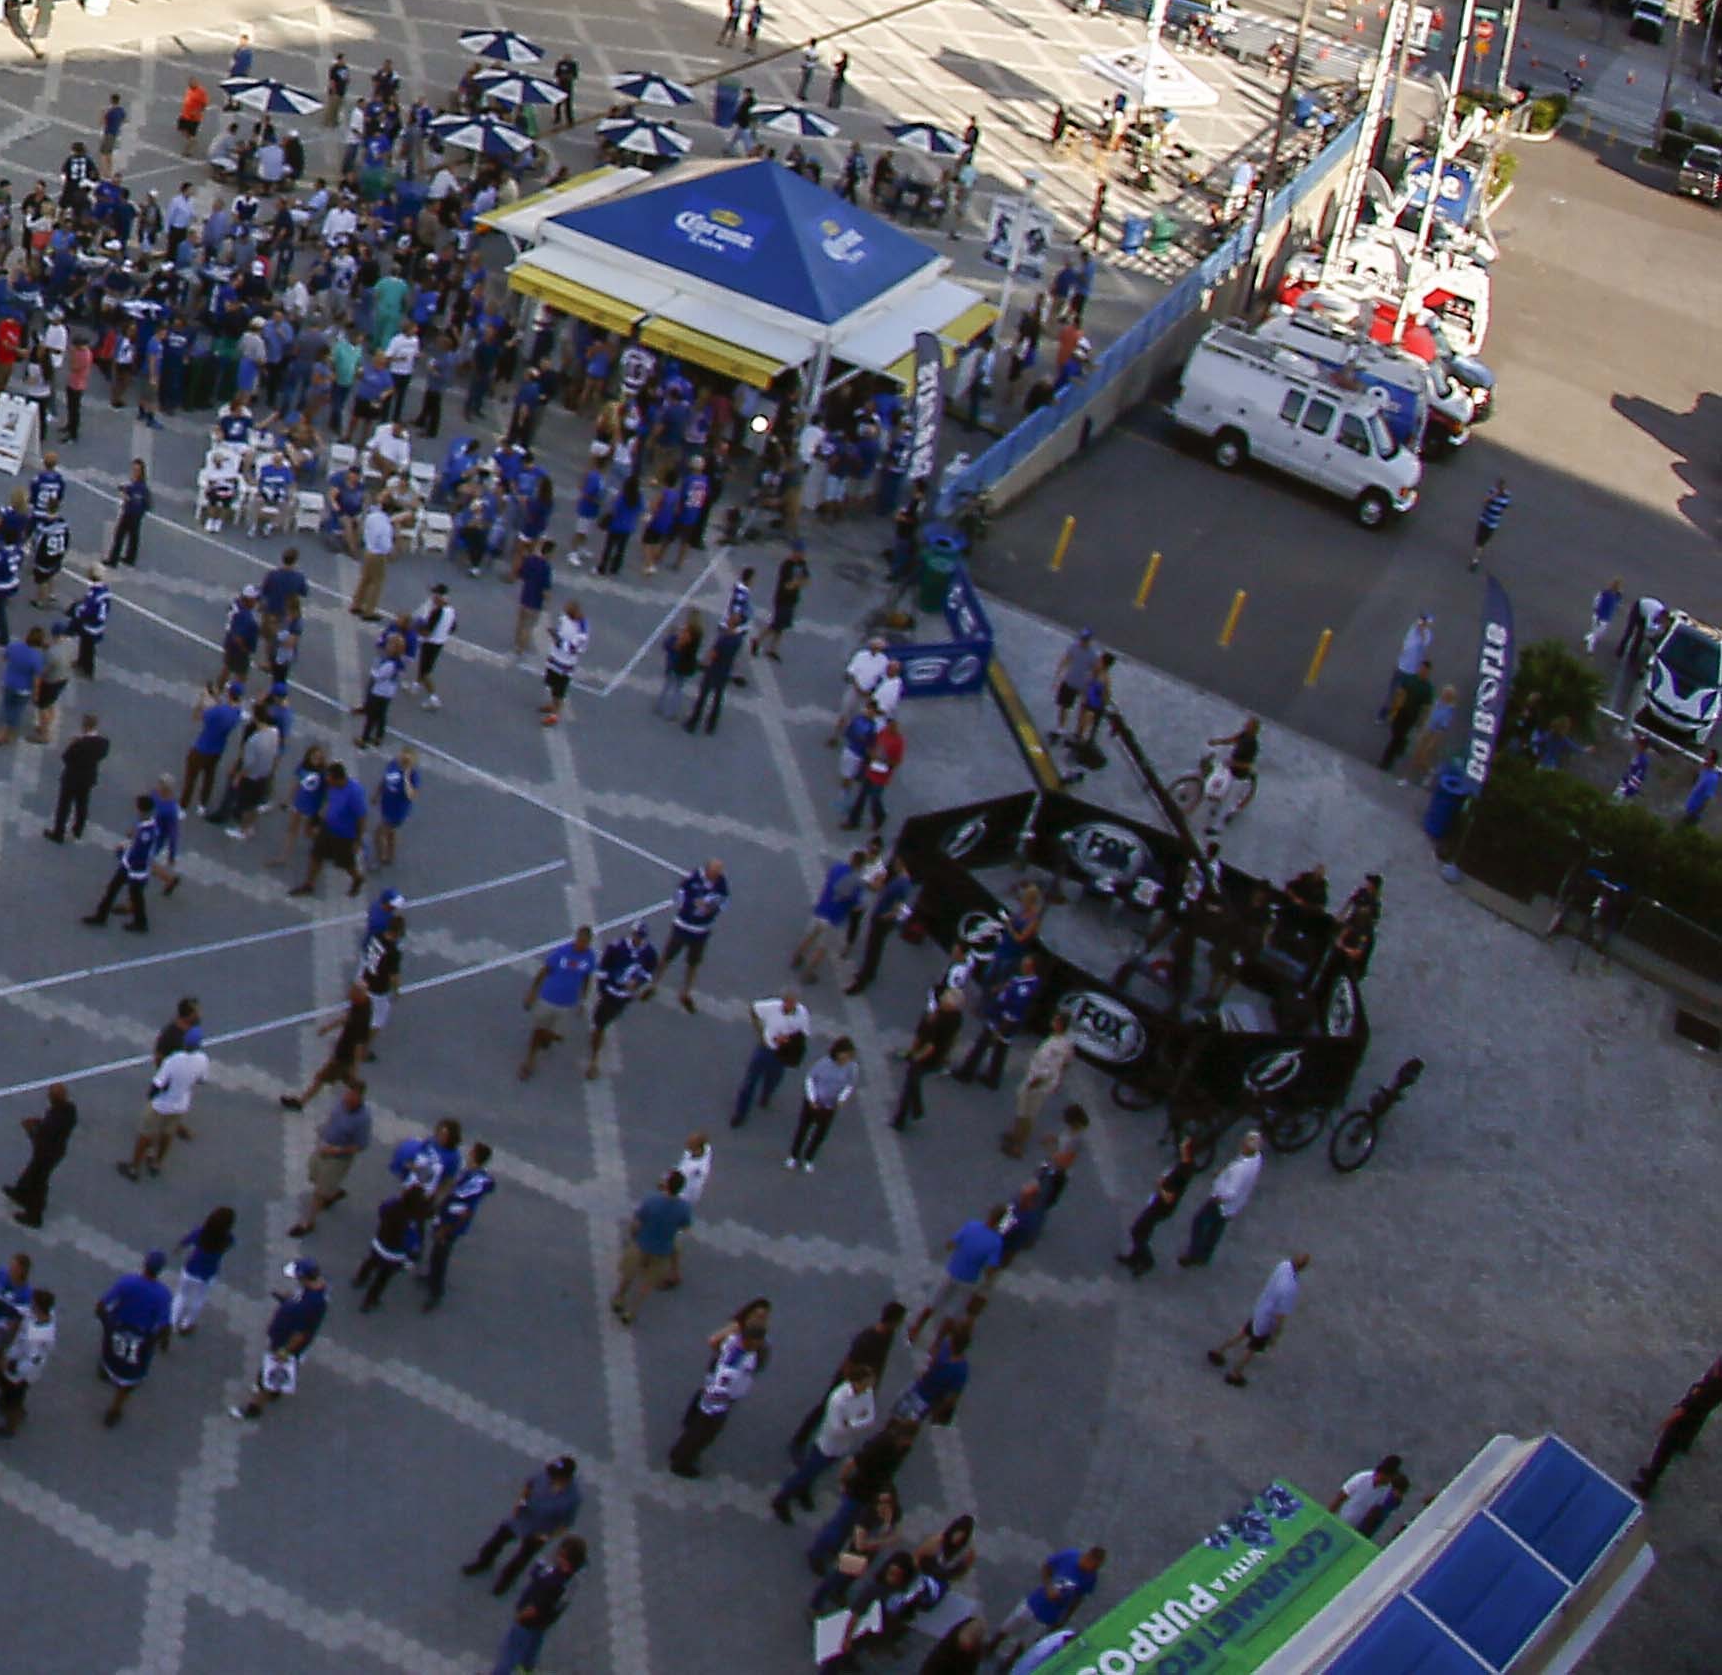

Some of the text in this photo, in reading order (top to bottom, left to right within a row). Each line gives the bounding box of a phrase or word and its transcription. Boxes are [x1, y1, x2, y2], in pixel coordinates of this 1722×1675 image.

[1086, 830, 1137, 867] FOX
[1076, 1000, 1130, 1038] FOX
[1198, 1528, 1334, 1649] GOURMET
[1209, 1548, 1269, 1593] WITH A
